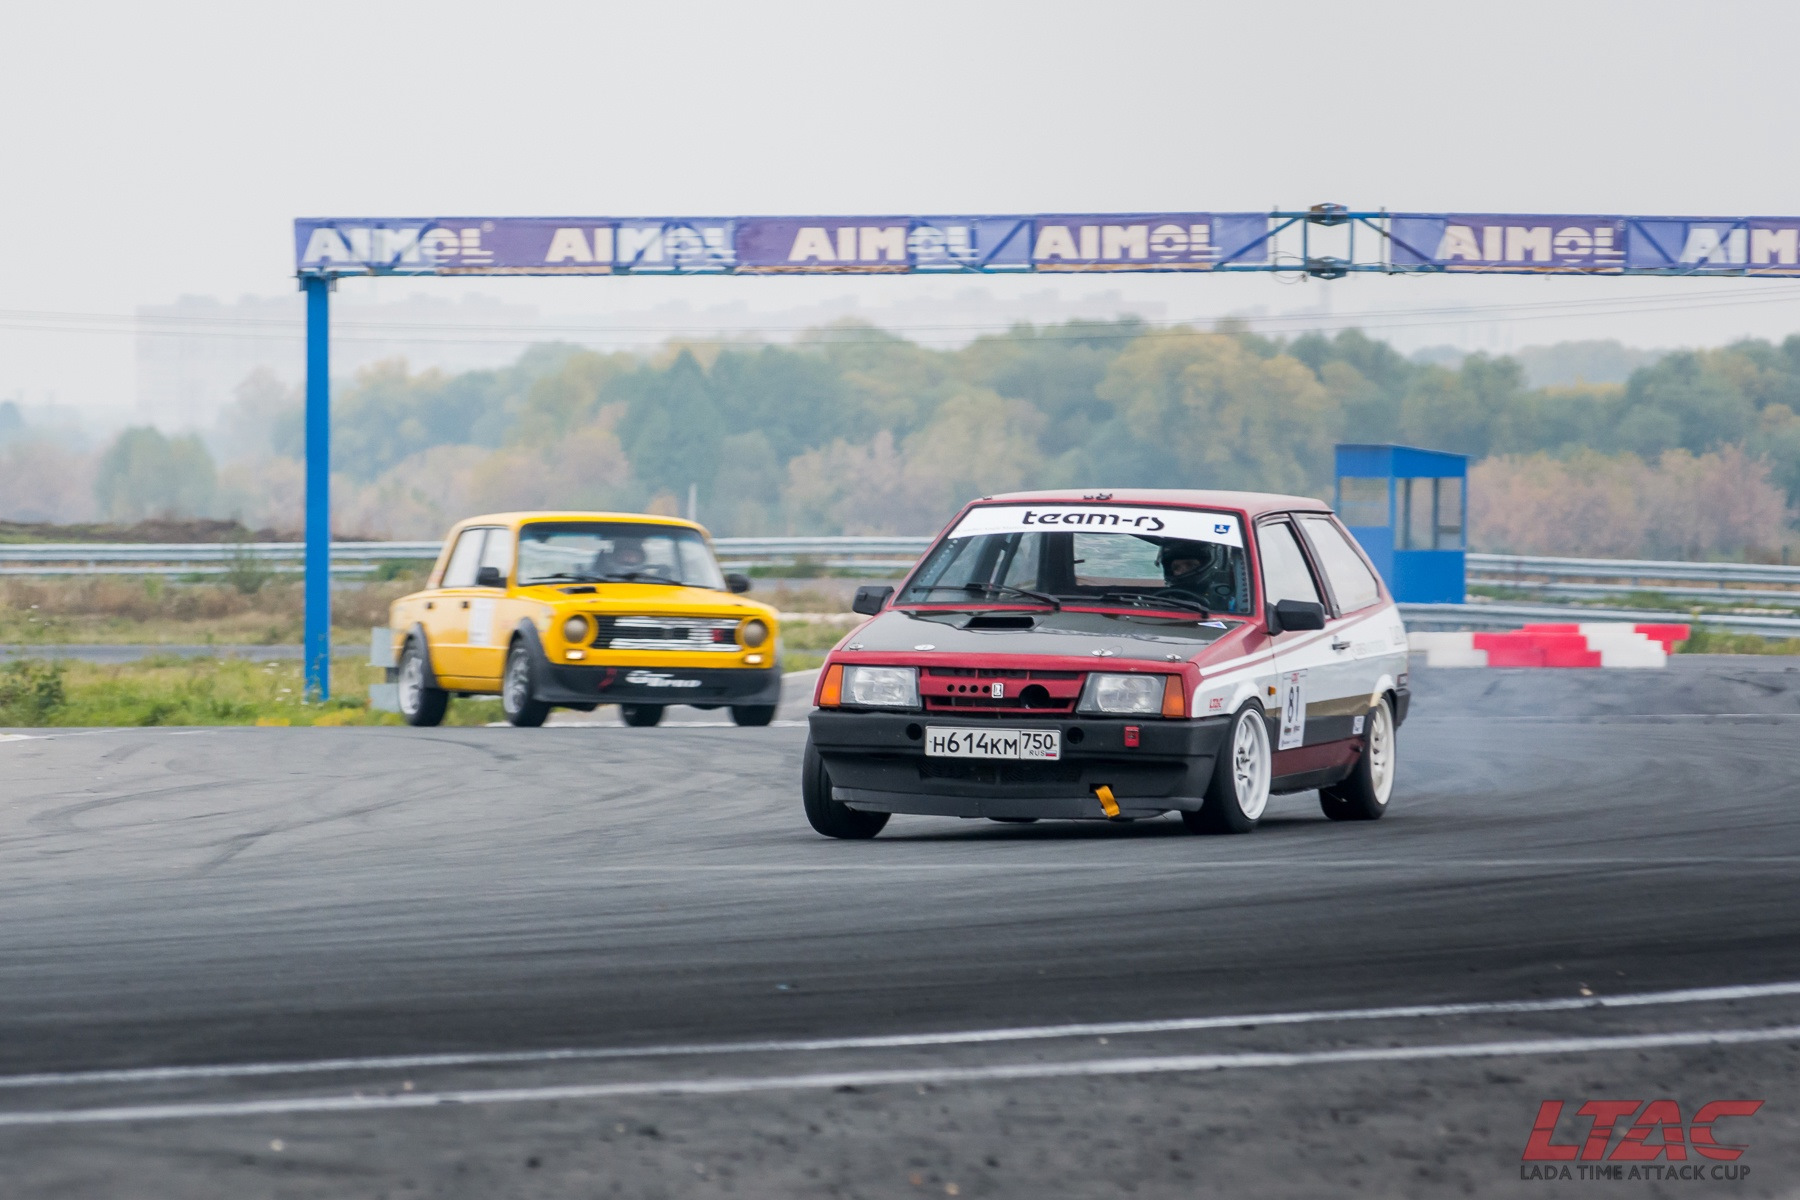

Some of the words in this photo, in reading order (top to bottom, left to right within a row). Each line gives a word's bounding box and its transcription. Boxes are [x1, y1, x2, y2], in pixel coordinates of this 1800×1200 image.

[301, 226, 495, 264] AIMOL
[544, 226, 737, 263] AIMOL
[787, 226, 980, 261] AIMOL
[1032, 224, 1223, 260] AIMOL
[1434, 225, 1627, 264] AIMOL
[1679, 227, 1800, 264] AIM
[1022, 510, 1165, 531] team-rs
[1021, 733, 1054, 750] 750
